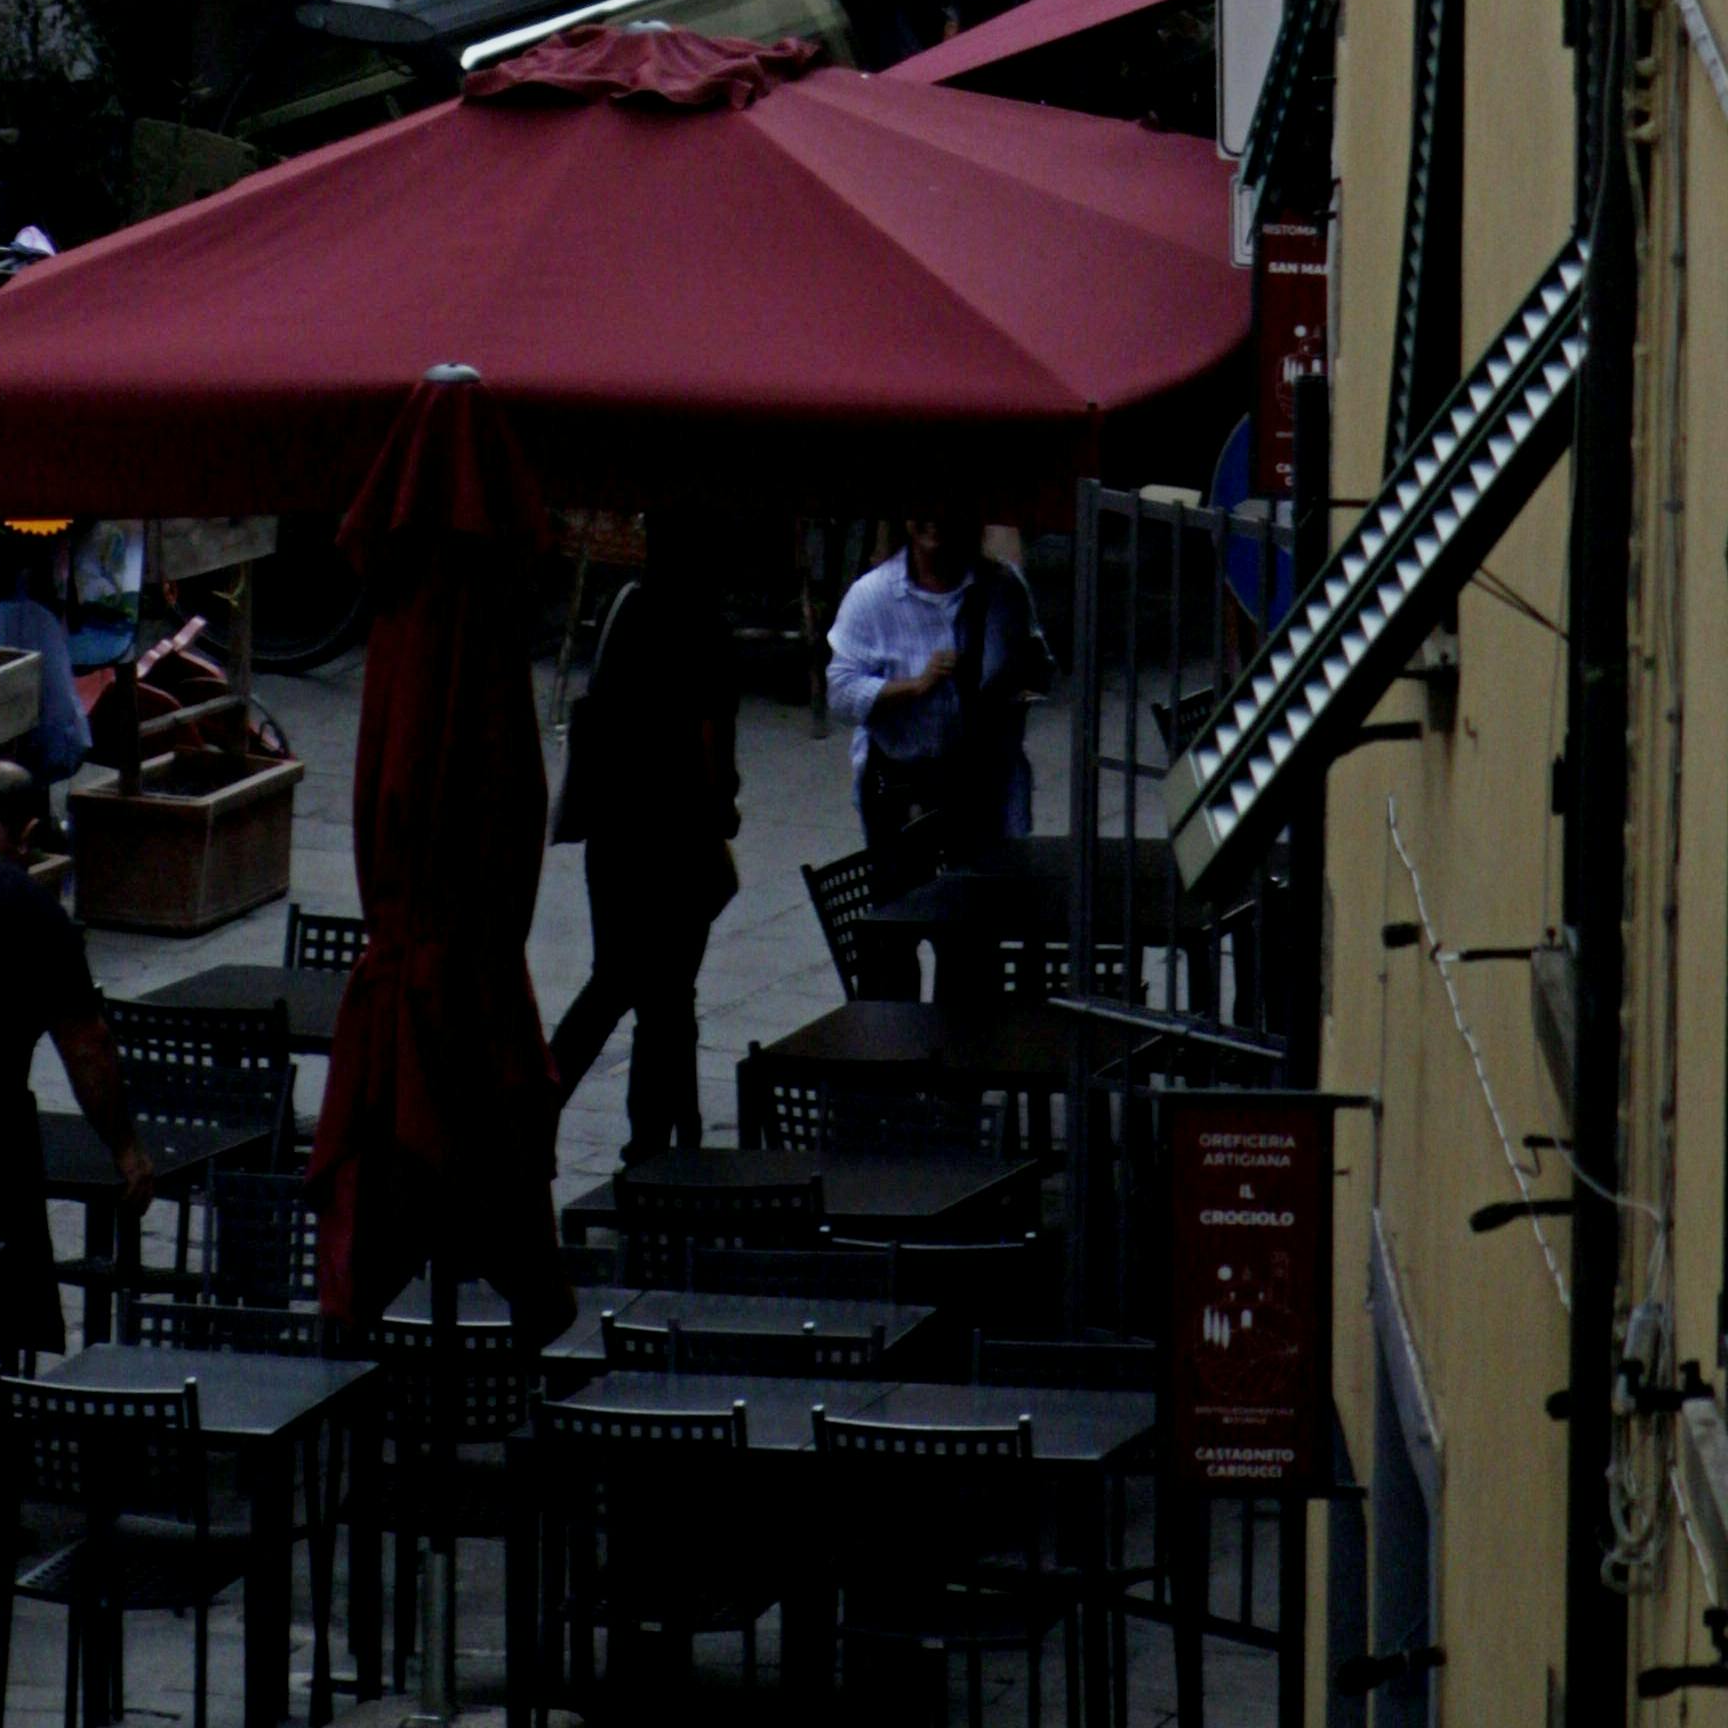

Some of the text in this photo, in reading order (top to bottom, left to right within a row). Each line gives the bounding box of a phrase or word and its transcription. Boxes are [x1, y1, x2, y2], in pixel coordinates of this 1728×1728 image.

[1268, 261, 1297, 274] SAN
[1199, 1209, 1295, 1227] CROGIOLO
[1194, 1446, 1296, 1463] CASTAGNETO
[1206, 1463, 1283, 1479] CARDUCCI
